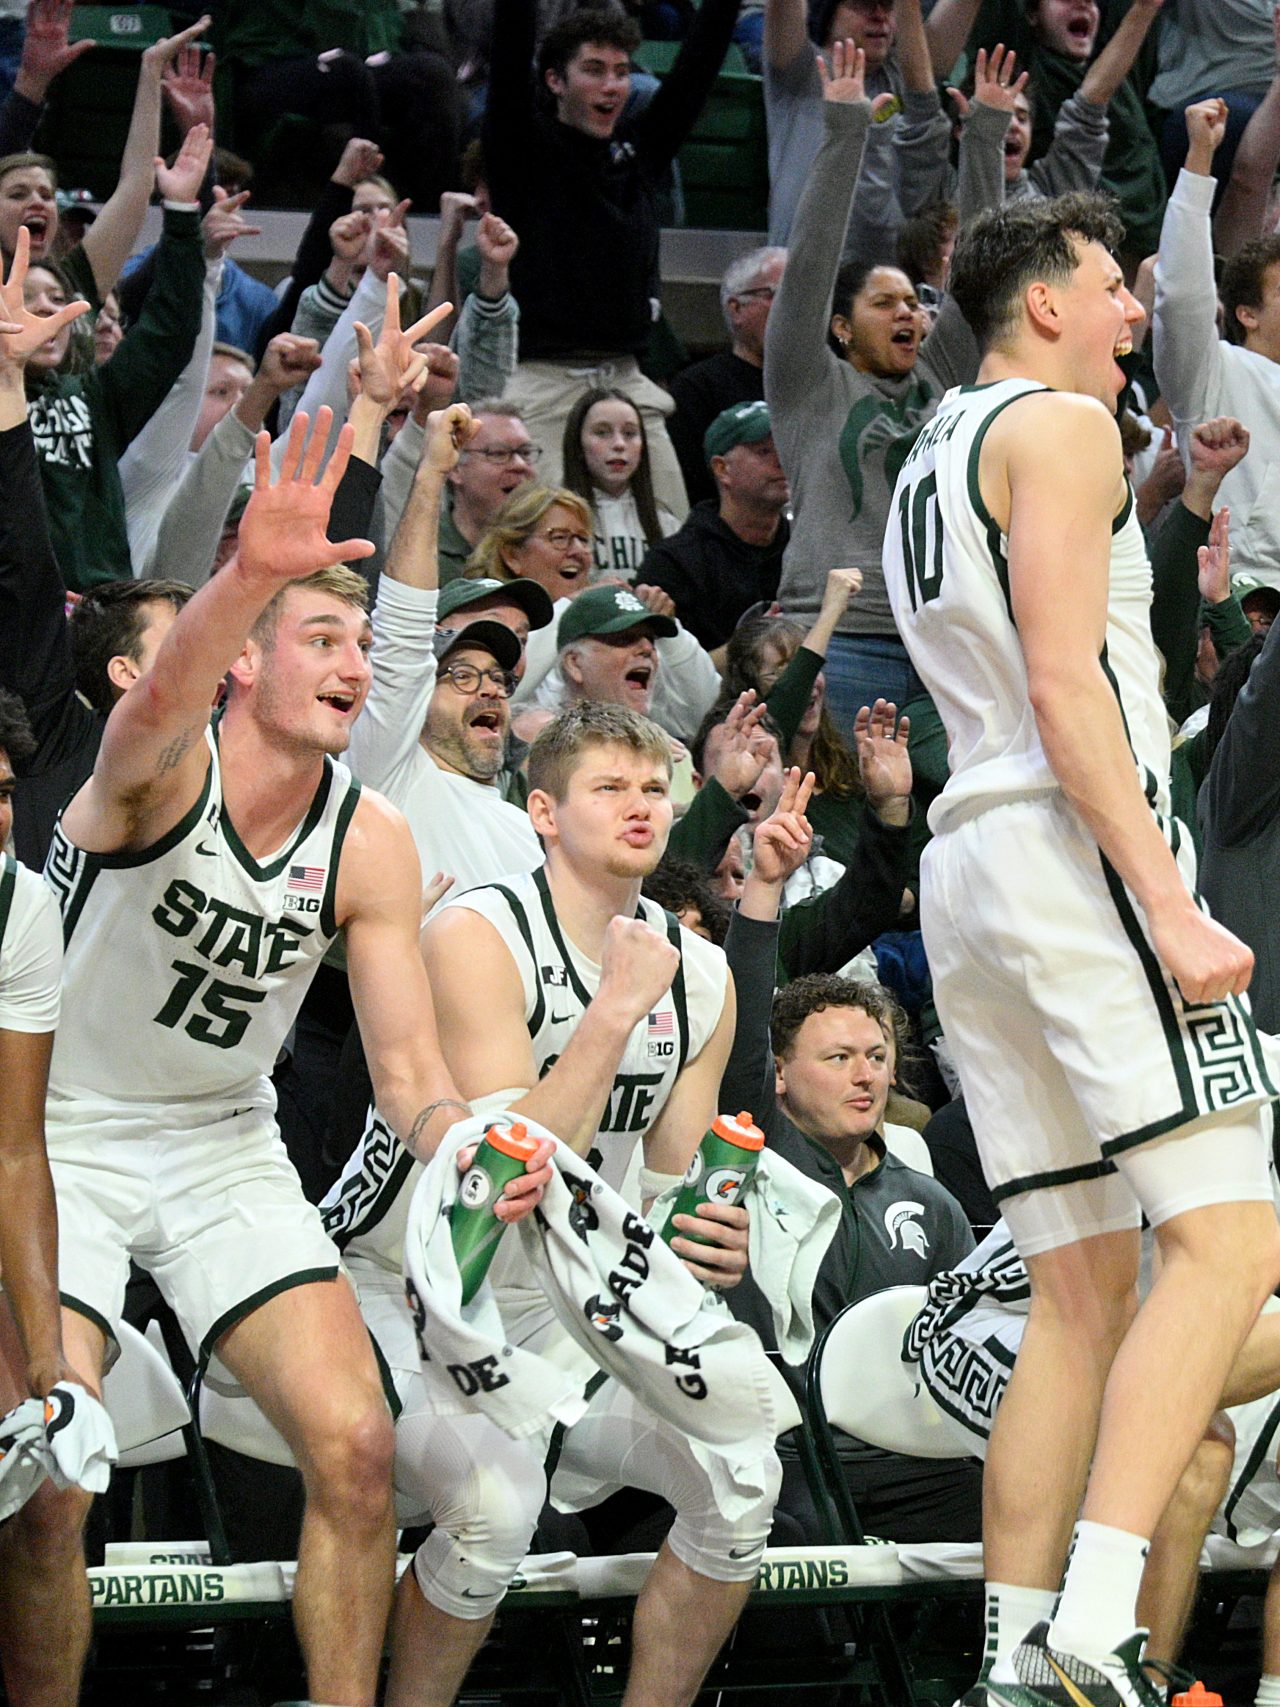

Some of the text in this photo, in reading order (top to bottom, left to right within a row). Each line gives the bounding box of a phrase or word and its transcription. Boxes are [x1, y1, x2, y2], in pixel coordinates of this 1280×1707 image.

[898, 469, 944, 614] 10
[151, 878, 316, 981] STATE
[152, 959, 269, 1050] 15
